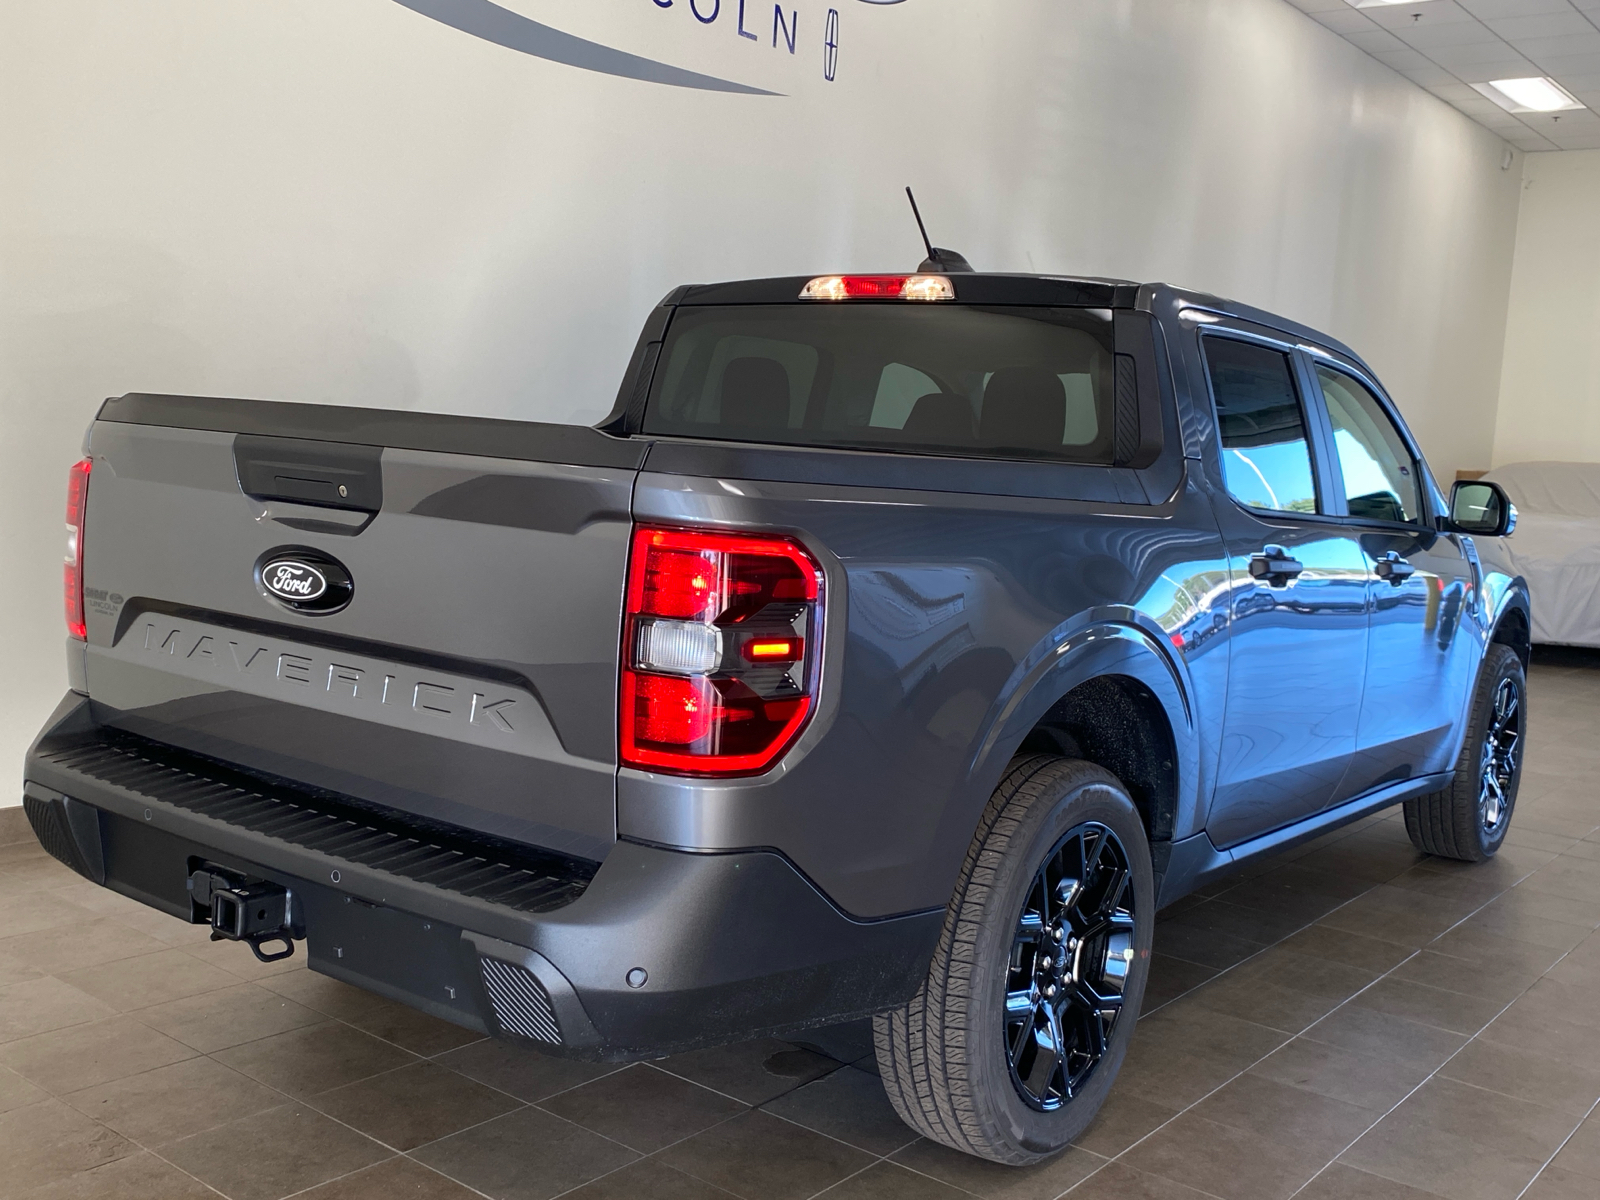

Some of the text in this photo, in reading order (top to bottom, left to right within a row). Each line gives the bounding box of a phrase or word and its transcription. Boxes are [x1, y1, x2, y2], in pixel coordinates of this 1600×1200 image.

[653, 0, 798, 55] OLN
[272, 565, 314, 594] Ford
[89, 600, 118, 612] LINCOLN
[143, 623, 517, 733] MAVERICK
